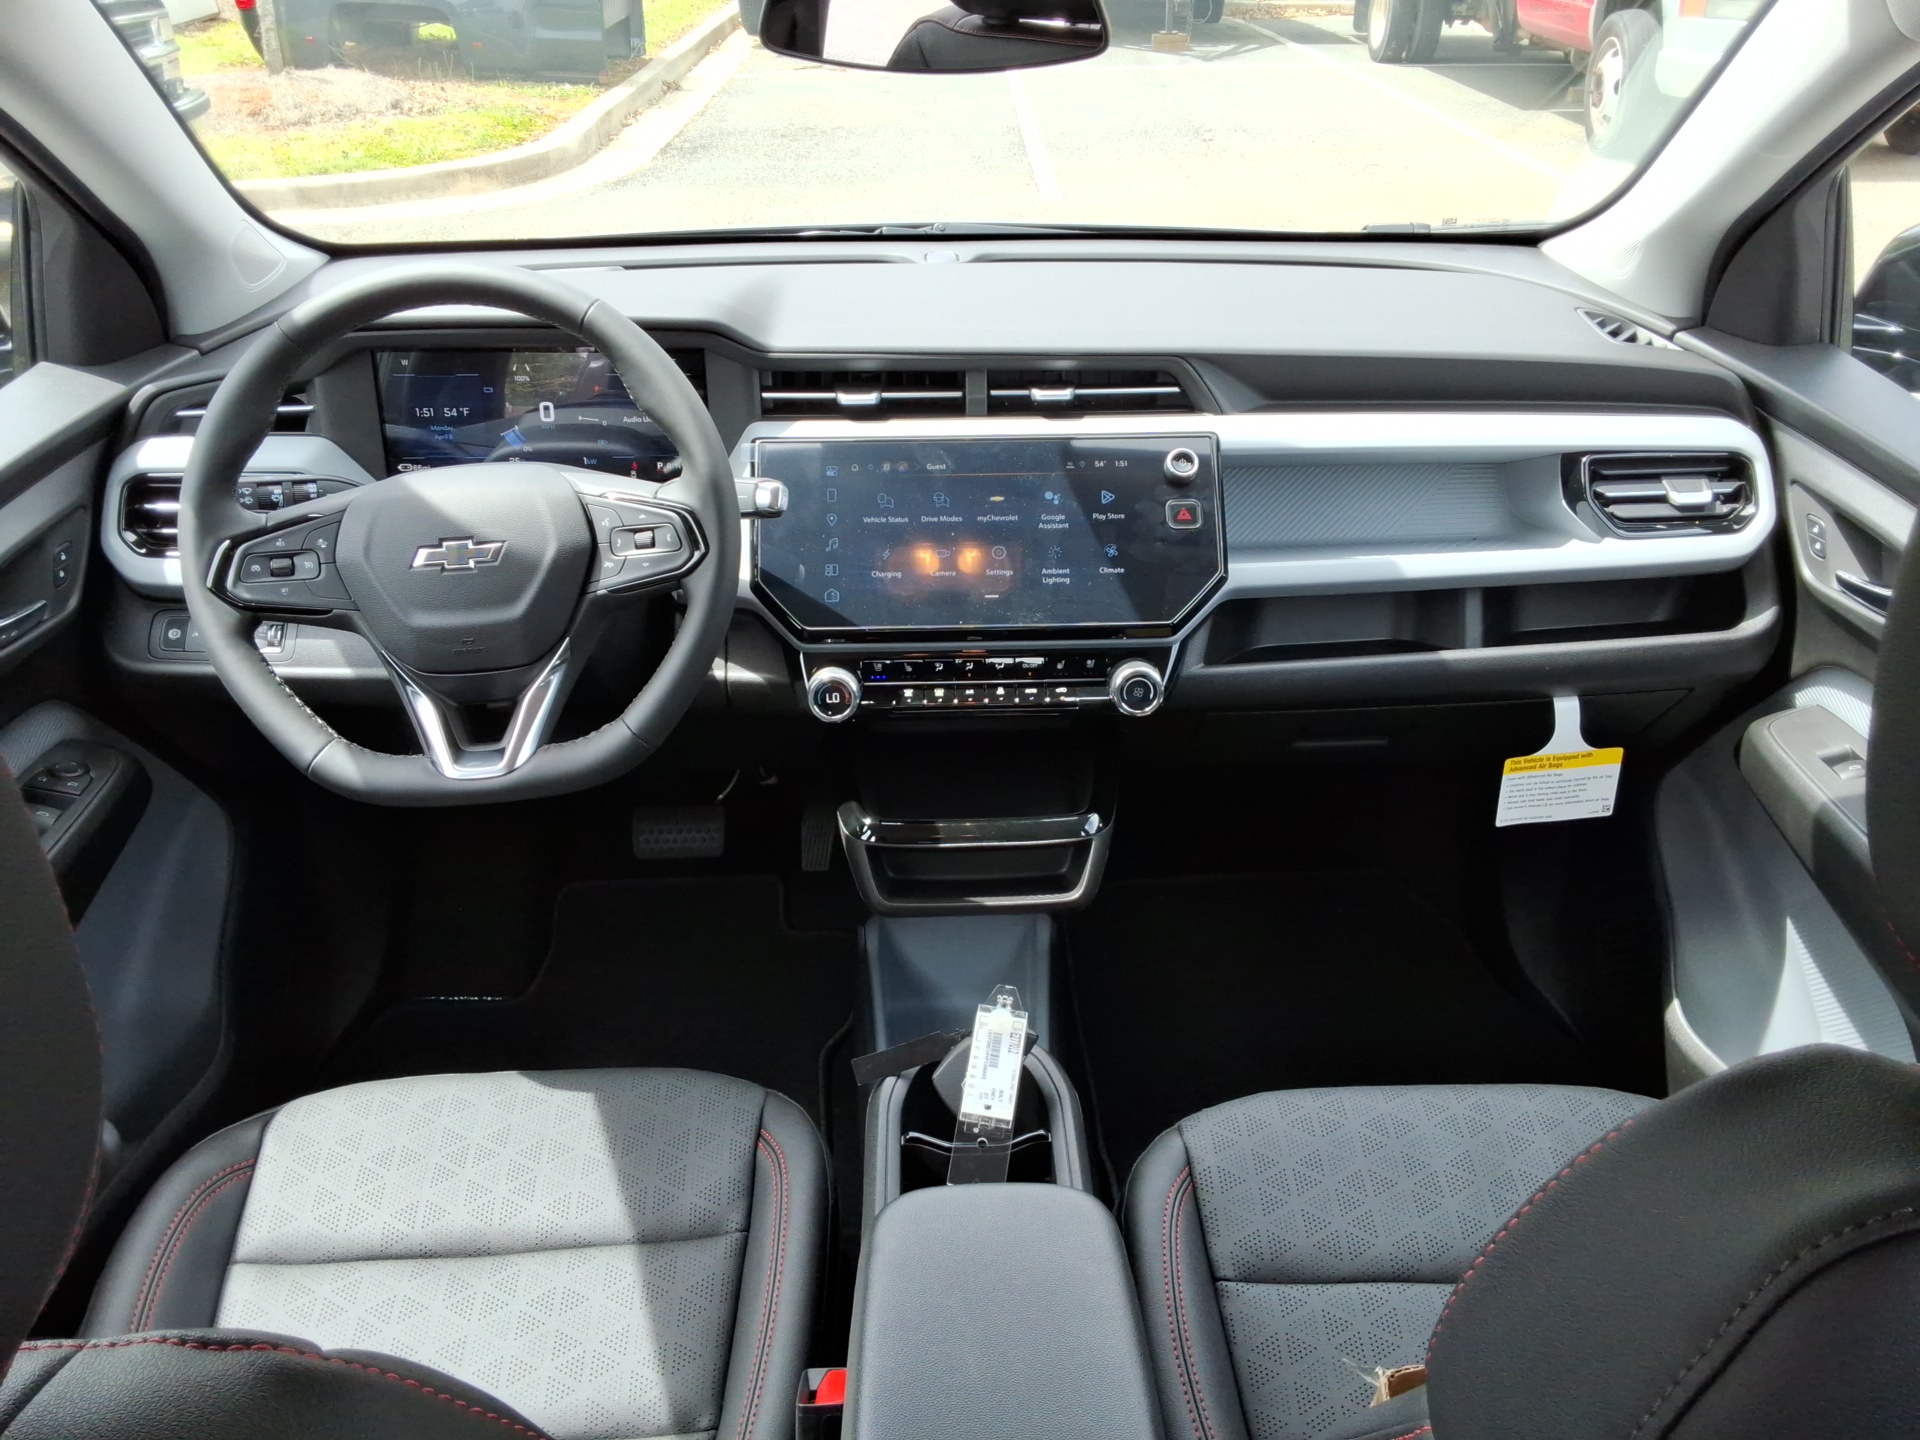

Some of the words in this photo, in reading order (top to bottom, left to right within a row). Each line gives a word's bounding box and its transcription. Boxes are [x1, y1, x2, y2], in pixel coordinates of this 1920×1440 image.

[415, 407, 434, 417] 1:51
[539, 401, 555, 422] 0
[656, 461, 664, 470] P
[977, 514, 1018, 522] myChevrolet
[1041, 513, 1066, 521] Google
[871, 570, 902, 579] Charging
[985, 568, 1014, 576] Settings
[825, 692, 840, 703] LO
[1552, 753, 1580, 762] Equipped
